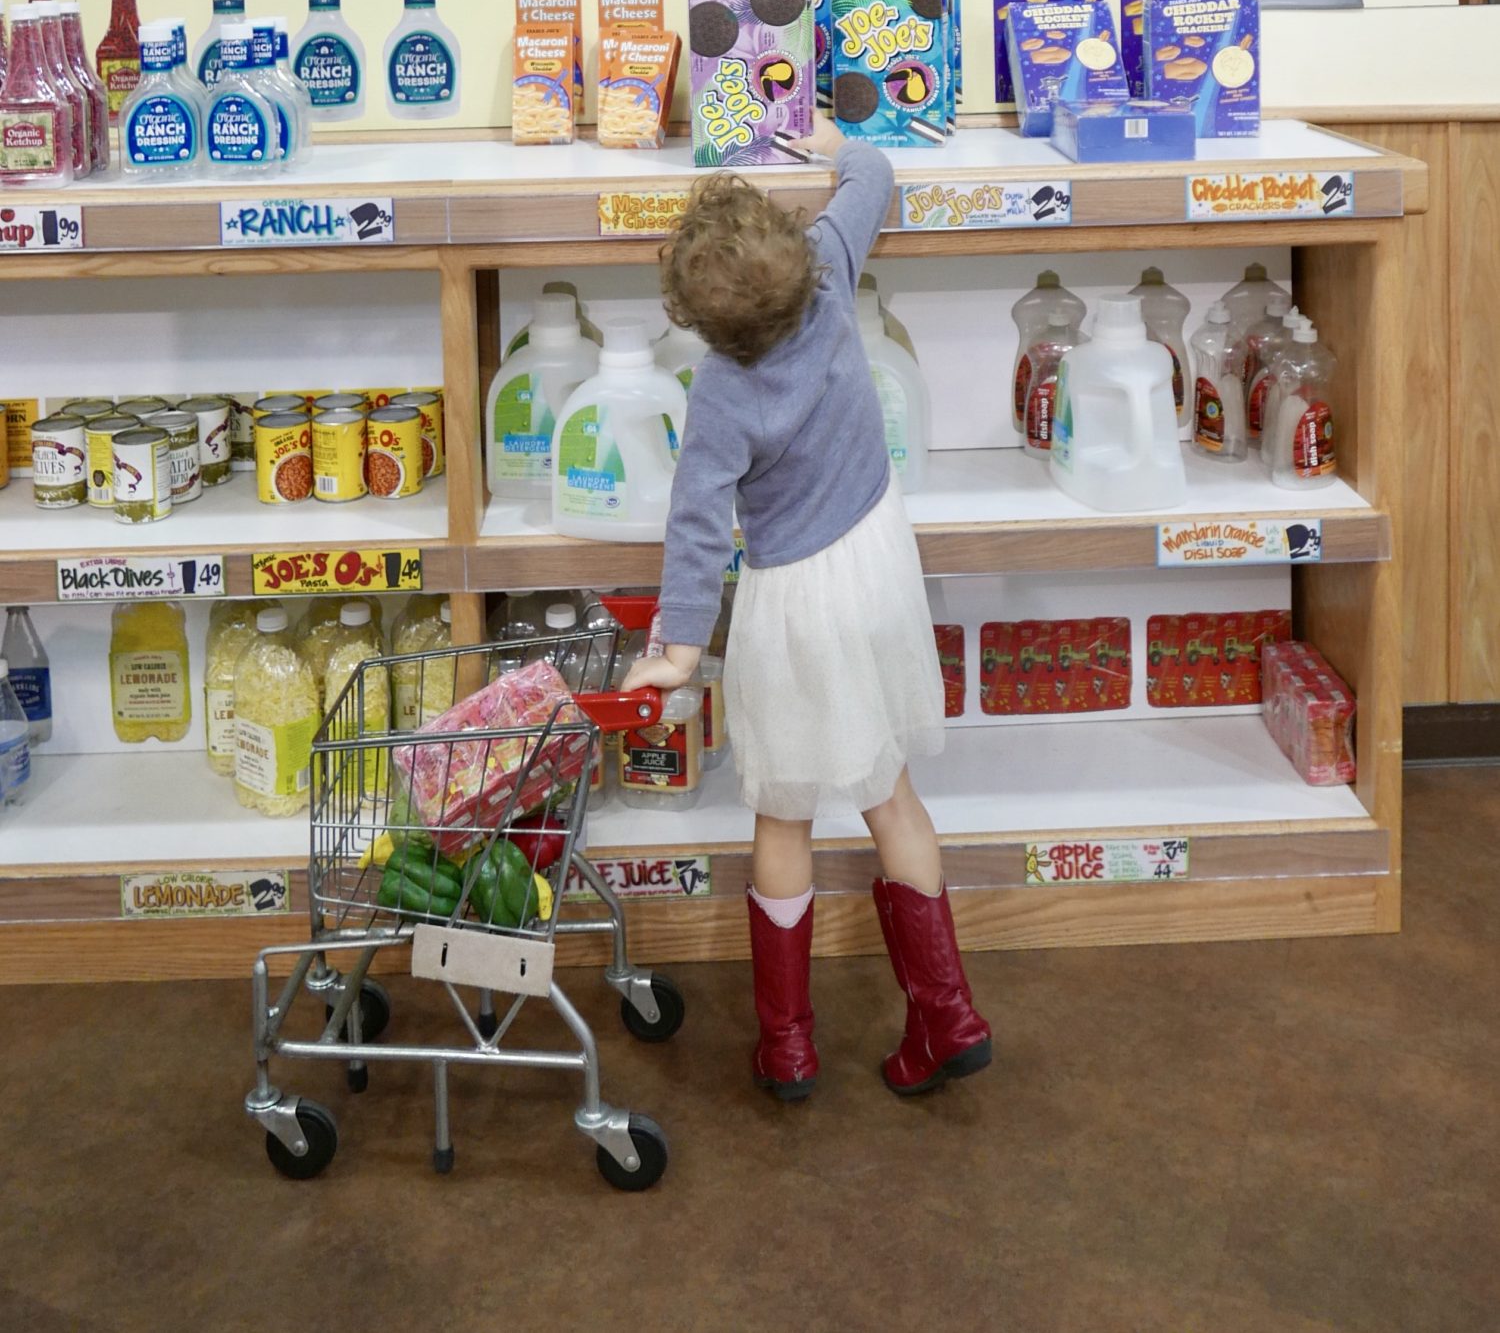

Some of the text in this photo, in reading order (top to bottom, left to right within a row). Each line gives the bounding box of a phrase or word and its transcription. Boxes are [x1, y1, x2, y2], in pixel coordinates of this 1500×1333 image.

[530, 9, 576, 21] Cheese
[612, 7, 657, 19] Cheese
[1023, 4, 1095, 18] CHEDDAR
[1033, 14, 1090, 25] ROCKET
[1173, 11, 1234, 27] ROCKET
[517, 36, 568, 47] Macaroni
[620, 41, 670, 53] Macaroni
[143, 47, 172, 56] RANCH
[527, 48, 566, 58] Cheese
[628, 52, 666, 63] Cheese
[304, 55, 347, 69] Organic
[400, 53, 442, 68] Organic
[300, 65, 352, 79] RANCH
[395, 62, 447, 77] RANCH
[303, 77, 351, 89] DRESSING
[397, 75, 446, 86] DRESSING
[139, 112, 181, 126] Organic
[216, 112, 253, 126] Organic
[7, 128, 40, 139] Organic
[135, 123, 186, 137] RANCH
[212, 123, 259, 136] RANCH
[6, 137, 43, 147] Ketchup
[136, 136, 186, 146] DRESSING
[214, 135, 259, 145] DRESSING
[1192, 174, 1259, 201] Cheddar
[1261, 173, 1316, 201] Rocket
[611, 195, 688, 213] Macaro
[1228, 201, 1281, 212] CRACKERS
[238, 204, 334, 236] RANCH
[1308, 422, 1319, 466] dish soap
[571, 474, 611, 484] LAUNDRY
[1163, 522, 1221, 553] Mandarin
[1223, 524, 1266, 549] Orange
[260, 553, 330, 589] JOE'S
[60, 567, 111, 590] Black
[110, 567, 164, 589] Olives
[120, 673, 178, 685] LEMONADE
[641, 752, 667, 761] APPLE
[642, 759, 666, 767] JUICE
[1049, 842, 1105, 865] apple
[1052, 860, 1105, 881] juice
[158, 874, 177, 885] LOW
[133, 883, 245, 909] LEMONADE
